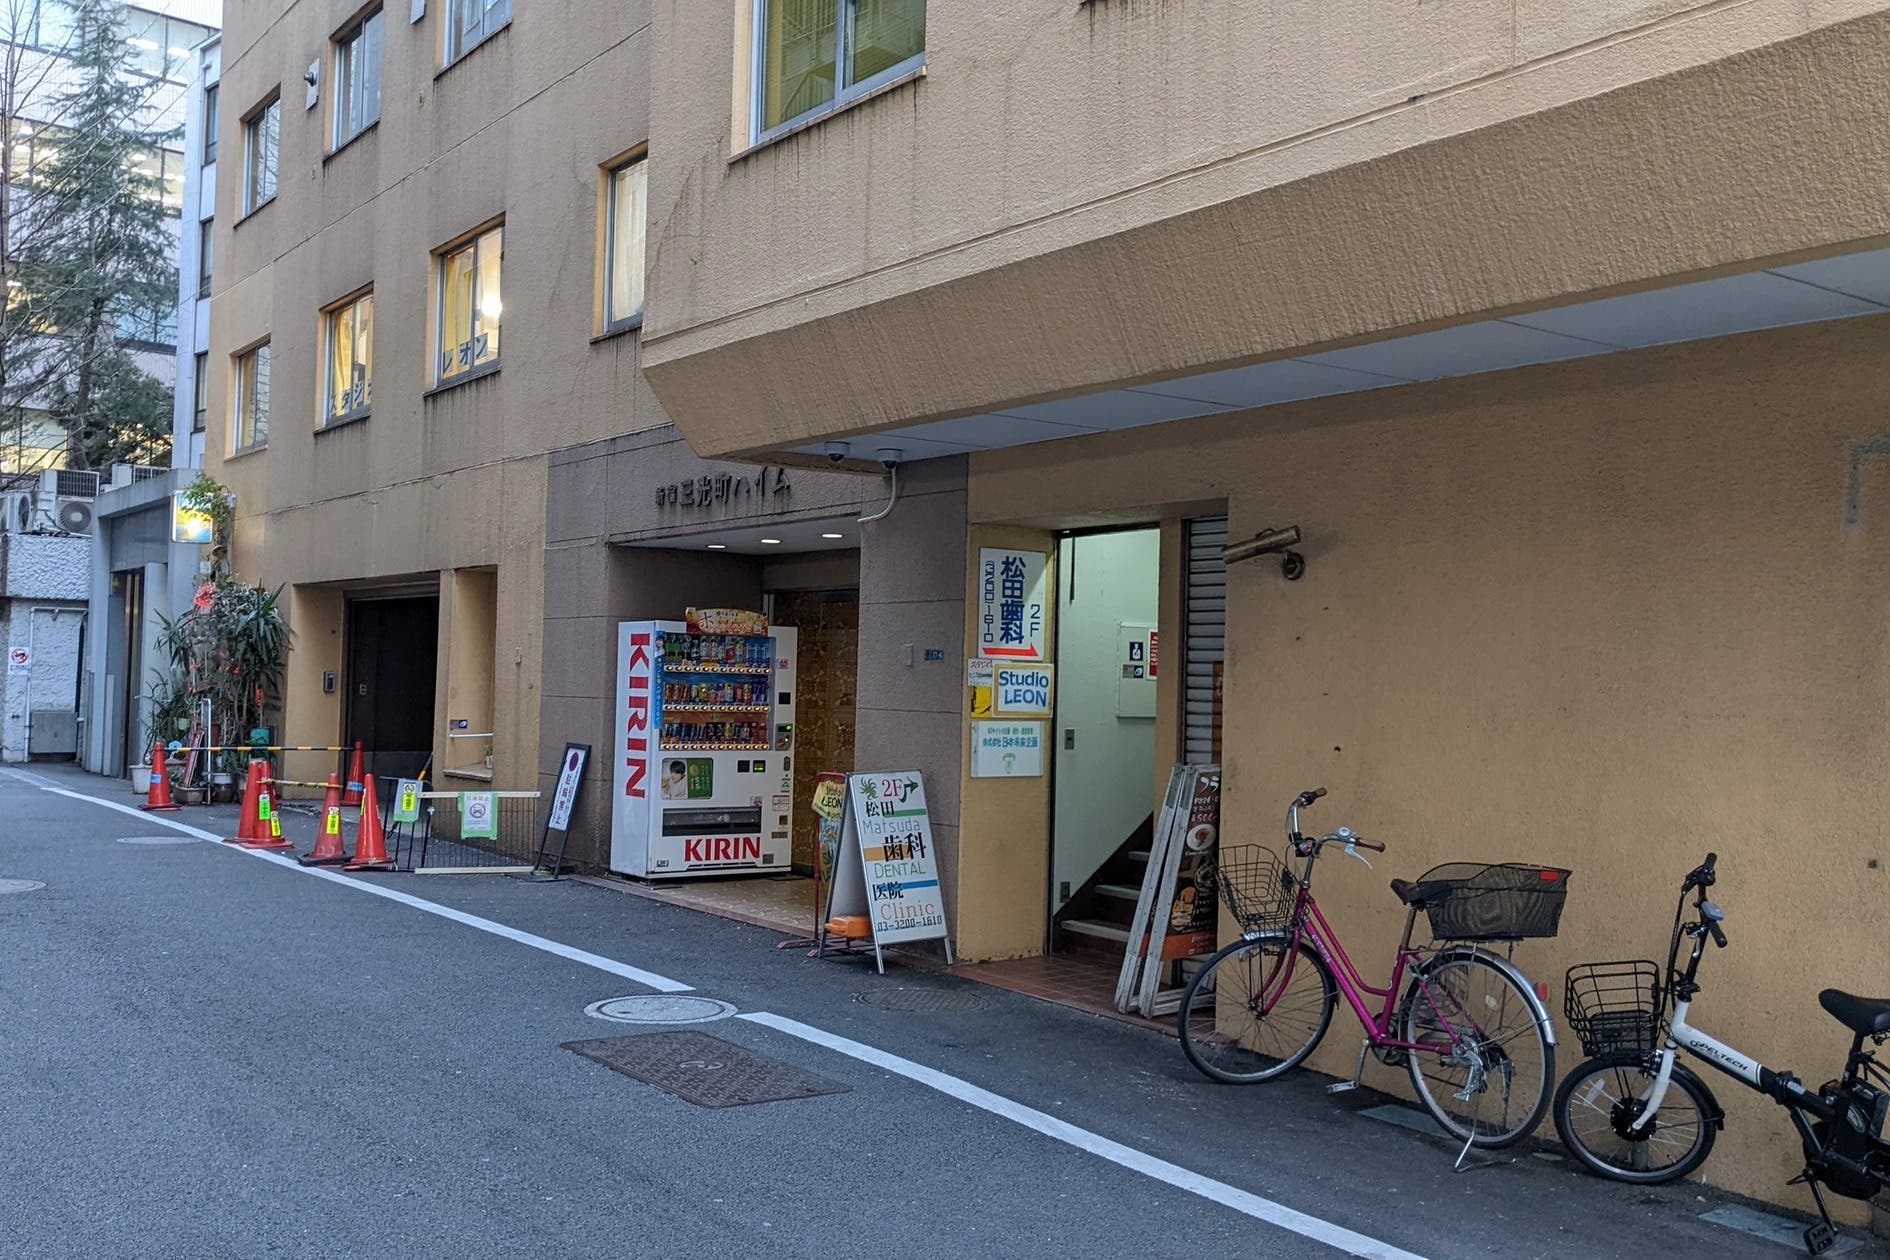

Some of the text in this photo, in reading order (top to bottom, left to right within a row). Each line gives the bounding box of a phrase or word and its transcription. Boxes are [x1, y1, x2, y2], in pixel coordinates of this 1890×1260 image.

[443, 335, 488, 374] レオン
[1000, 555, 1026, 644] 松田歯科
[1029, 604, 1040, 638] 2F
[999, 671, 1049, 688] Studio
[1004, 689, 1047, 708] LEON
[626, 633, 650, 798] KIRIN
[882, 779, 904, 797] 2F
[821, 796, 842, 809] LEON
[866, 801, 895, 818] 松田
[862, 818, 920, 835] Matsuda
[684, 836, 761, 862] KIRIN
[881, 832, 927, 862] 歯科
[874, 862, 926, 878] DENTAL
[872, 881, 904, 901] 医院
[881, 900, 935, 920] Clinic
[877, 915, 943, 933] 03-3200-1610
